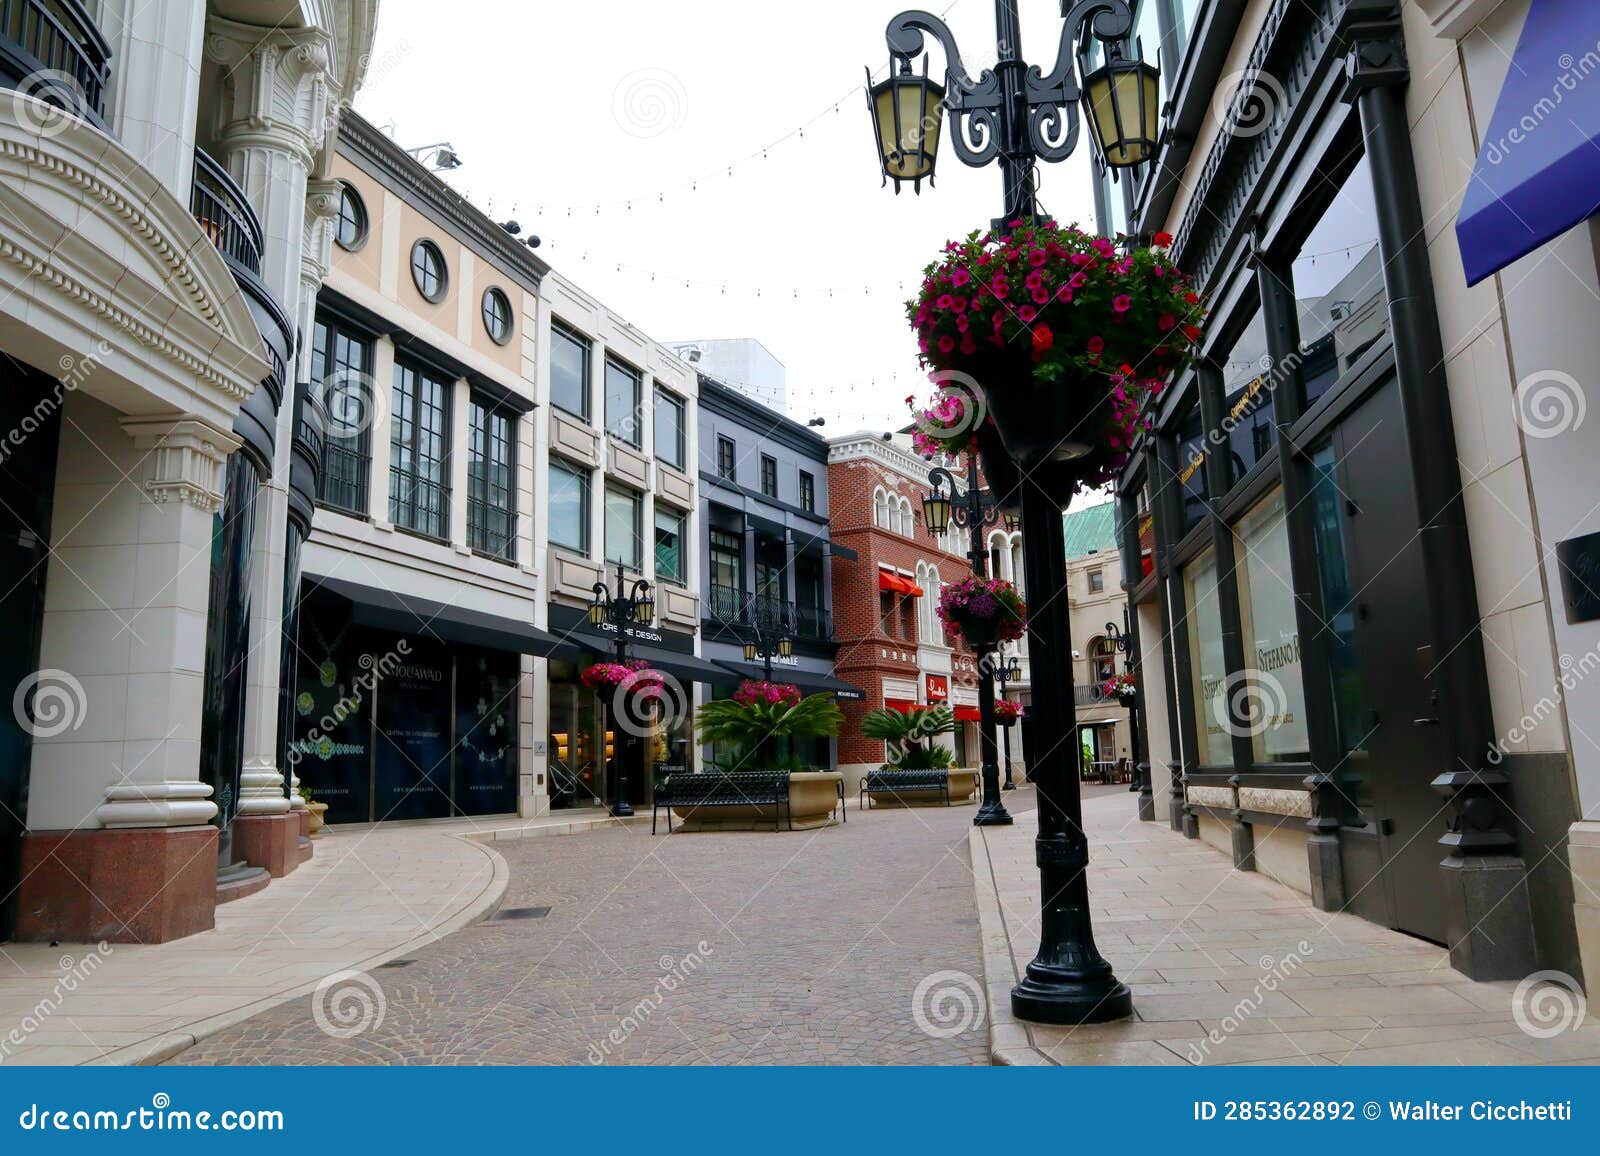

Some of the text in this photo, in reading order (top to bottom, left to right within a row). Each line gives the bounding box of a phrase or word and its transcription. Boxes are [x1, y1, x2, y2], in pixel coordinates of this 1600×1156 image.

[597, 622, 662, 642] ORSHE DESIGN
[1259, 643, 1293, 672] STEFANO
